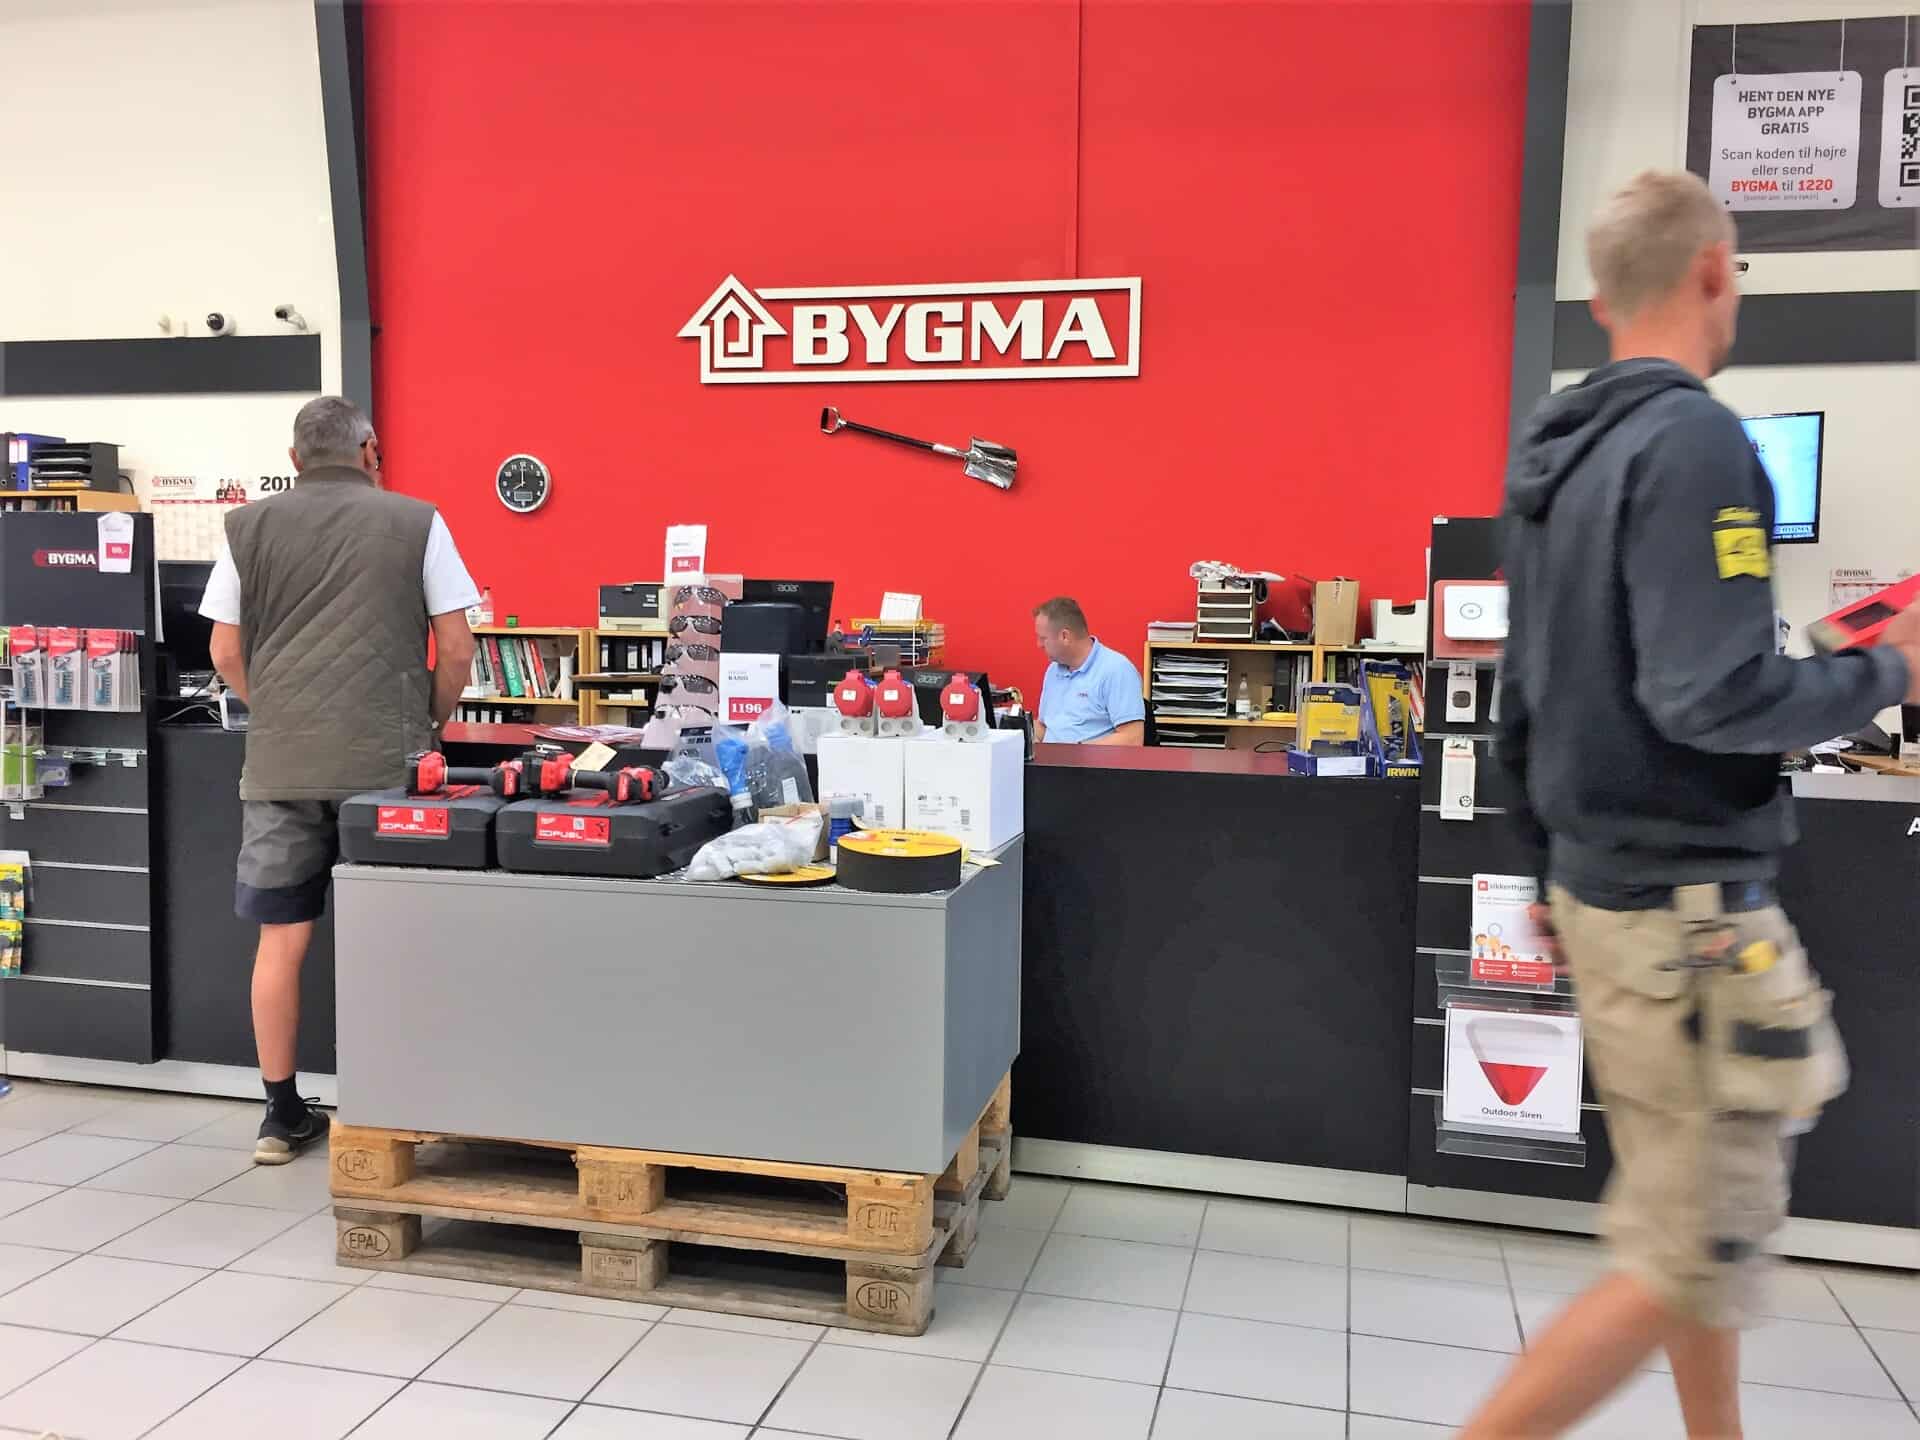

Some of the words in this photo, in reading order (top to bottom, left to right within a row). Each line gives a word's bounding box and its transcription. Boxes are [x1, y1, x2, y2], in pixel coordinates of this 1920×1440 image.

[1738, 91, 1773, 103] HENT
[1777, 90, 1803, 102] DEN
[1807, 89, 1836, 101] NYE
[1748, 106, 1795, 119] BYGMA
[1798, 106, 1824, 117] APP
[1761, 122, 1809, 135] GRATIS
[1721, 148, 1752, 160] Scan
[1756, 148, 1794, 160] koden
[1798, 147, 1810, 158] til
[1815, 146, 1847, 160] højre
[1752, 164, 1778, 176] eller
[1782, 163, 1813, 175] send
[1731, 180, 1778, 192] BYGMA
[1782, 180, 1793, 191] til
[1798, 179, 1833, 191] 1220
[792, 297, 1116, 365] BYGMA
[259, 476, 297, 492] 201
[48, 552, 96, 565] BYGMA
[917, 674, 942, 684] acer
[732, 703, 762, 714] 1196
[1387, 767, 1419, 777] IRWIN
[1481, 1106, 1517, 1117] Outdoor
[1519, 1110, 1543, 1120] Siren
[349, 1232, 382, 1252] EPAL
[867, 1287, 899, 1311] EUR
